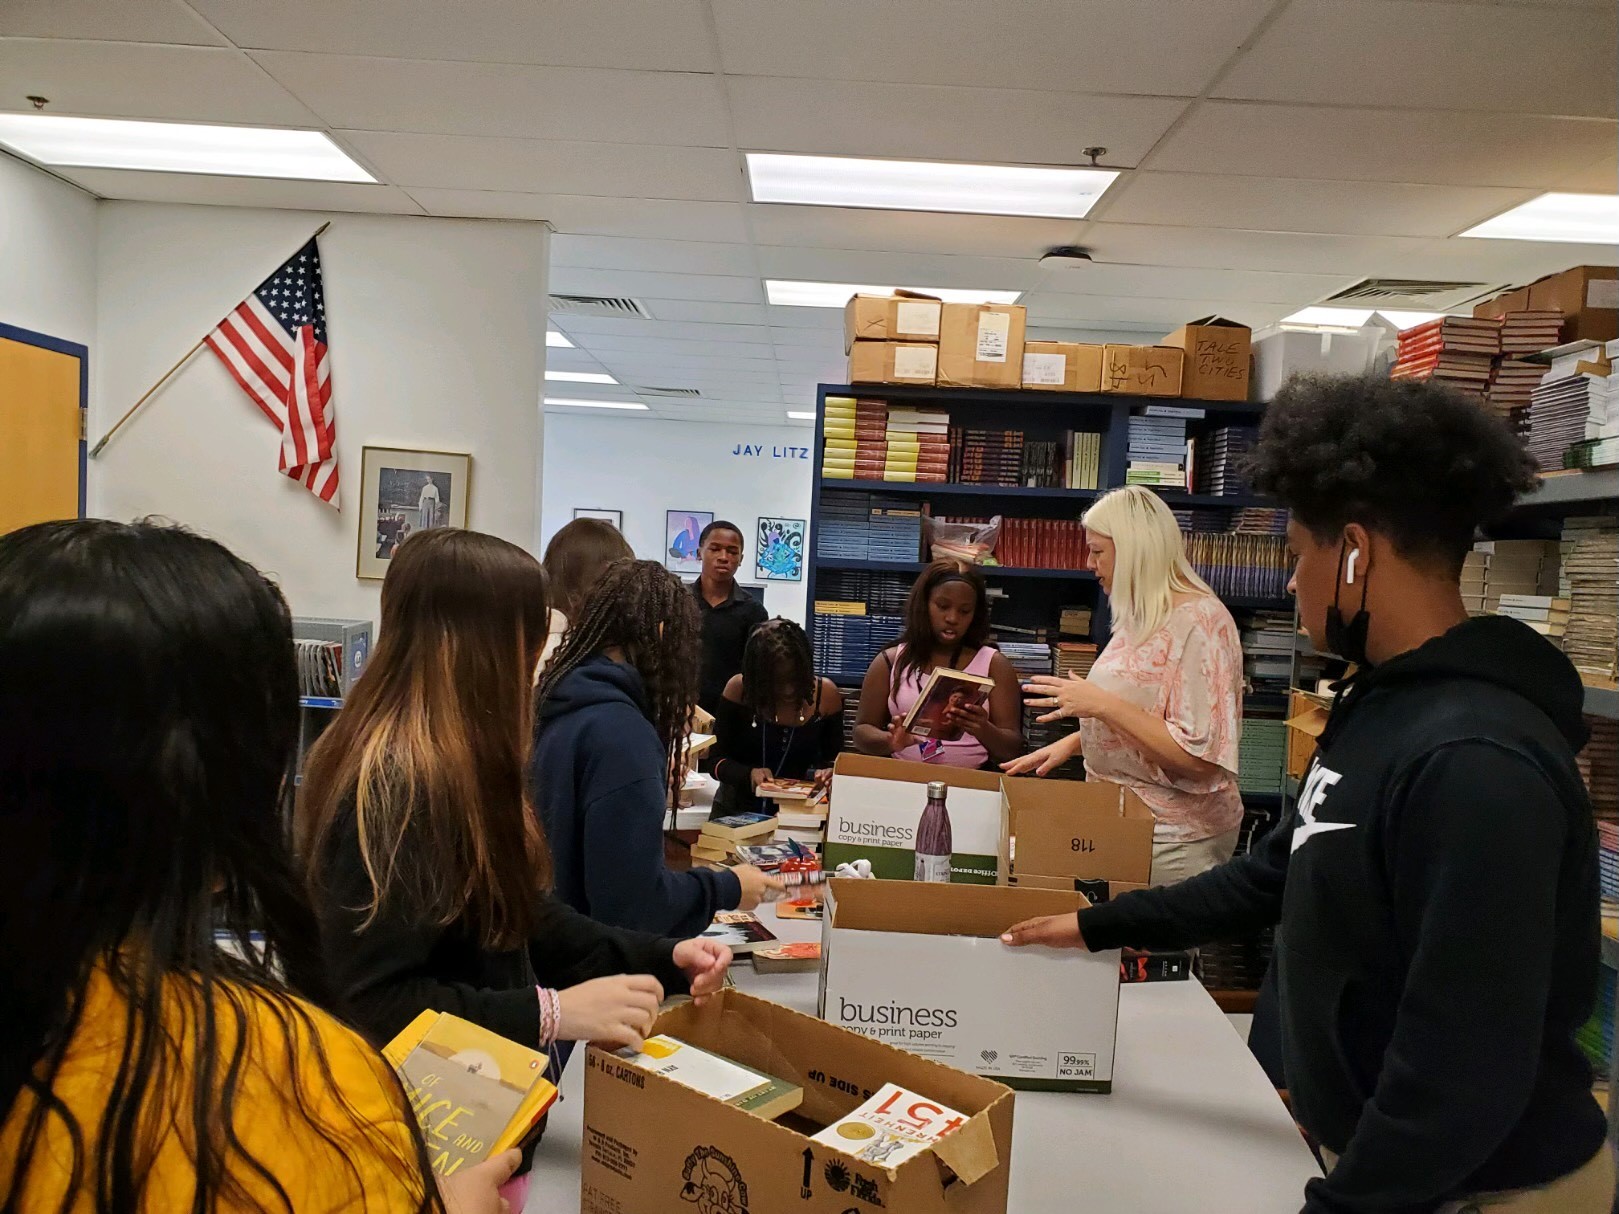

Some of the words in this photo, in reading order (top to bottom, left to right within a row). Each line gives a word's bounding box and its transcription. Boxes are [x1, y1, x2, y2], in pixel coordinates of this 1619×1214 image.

[1197, 340, 1240, 354] TALE
[1200, 353, 1235, 365] TWO
[1198, 365, 1246, 380] CITIES
[733, 444, 762, 457] JAY
[772, 446, 809, 459] LITZ
[839, 817, 913, 840] business
[838, 834, 856, 843] copy
[863, 836, 881, 845] print
[882, 839, 903, 847] paper
[1071, 838, 1096, 853] 118
[973, 869, 998, 877] Office
[840, 996, 957, 1028] business
[878, 1026, 906, 1038] print
[909, 1029, 943, 1041] paper
[422, 1074, 441, 1087] OF
[615, 1066, 646, 1090] CARTONS
[808, 1069, 826, 1084] UP
[1074, 1069, 1092, 1077] JAM
[829, 1076, 859, 1096] SIDE
[858, 1111, 939, 1144] HRENHEIT
[453, 1133, 484, 1154] AND
[801, 1186, 812, 1200] UP
